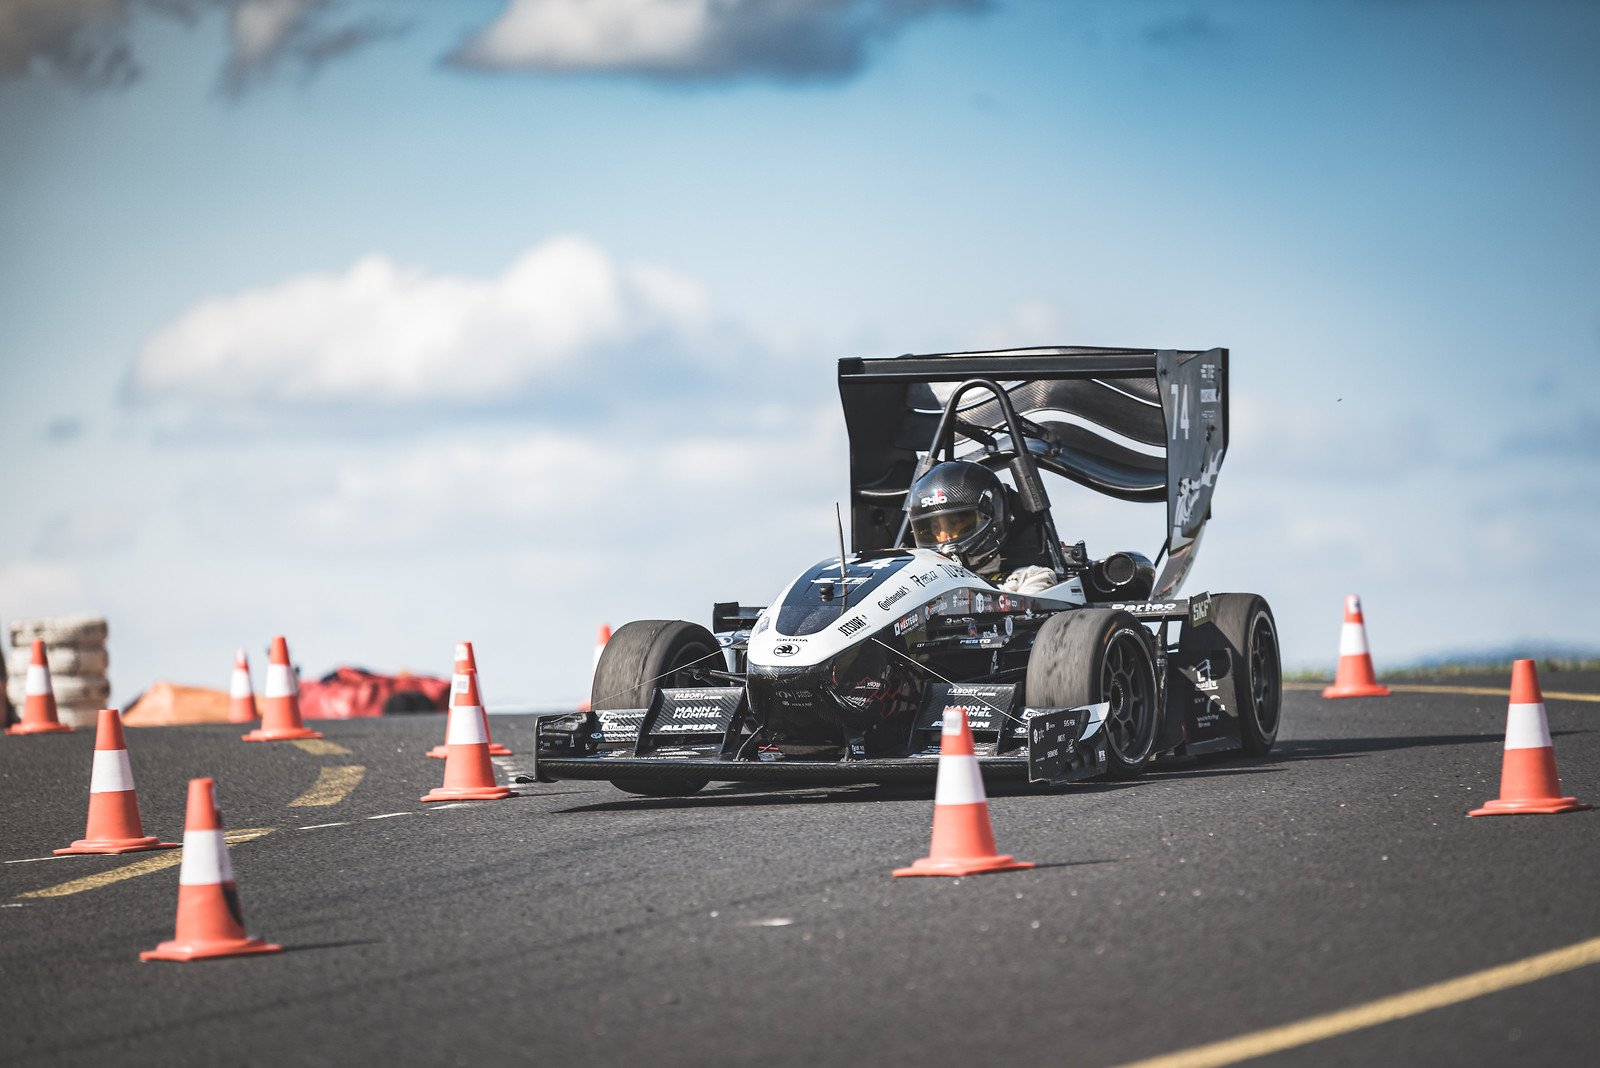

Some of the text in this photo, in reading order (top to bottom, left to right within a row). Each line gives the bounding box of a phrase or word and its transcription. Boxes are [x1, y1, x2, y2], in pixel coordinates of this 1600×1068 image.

[1170, 383, 1190, 440] 74
[1192, 600, 1210, 621] SKF
[946, 687, 979, 695] FABORY
[673, 692, 706, 700] FABORY
[674, 705, 722, 713] MANN+
[672, 711, 722, 719] HUMMEL
[659, 723, 718, 731] ALFUN
